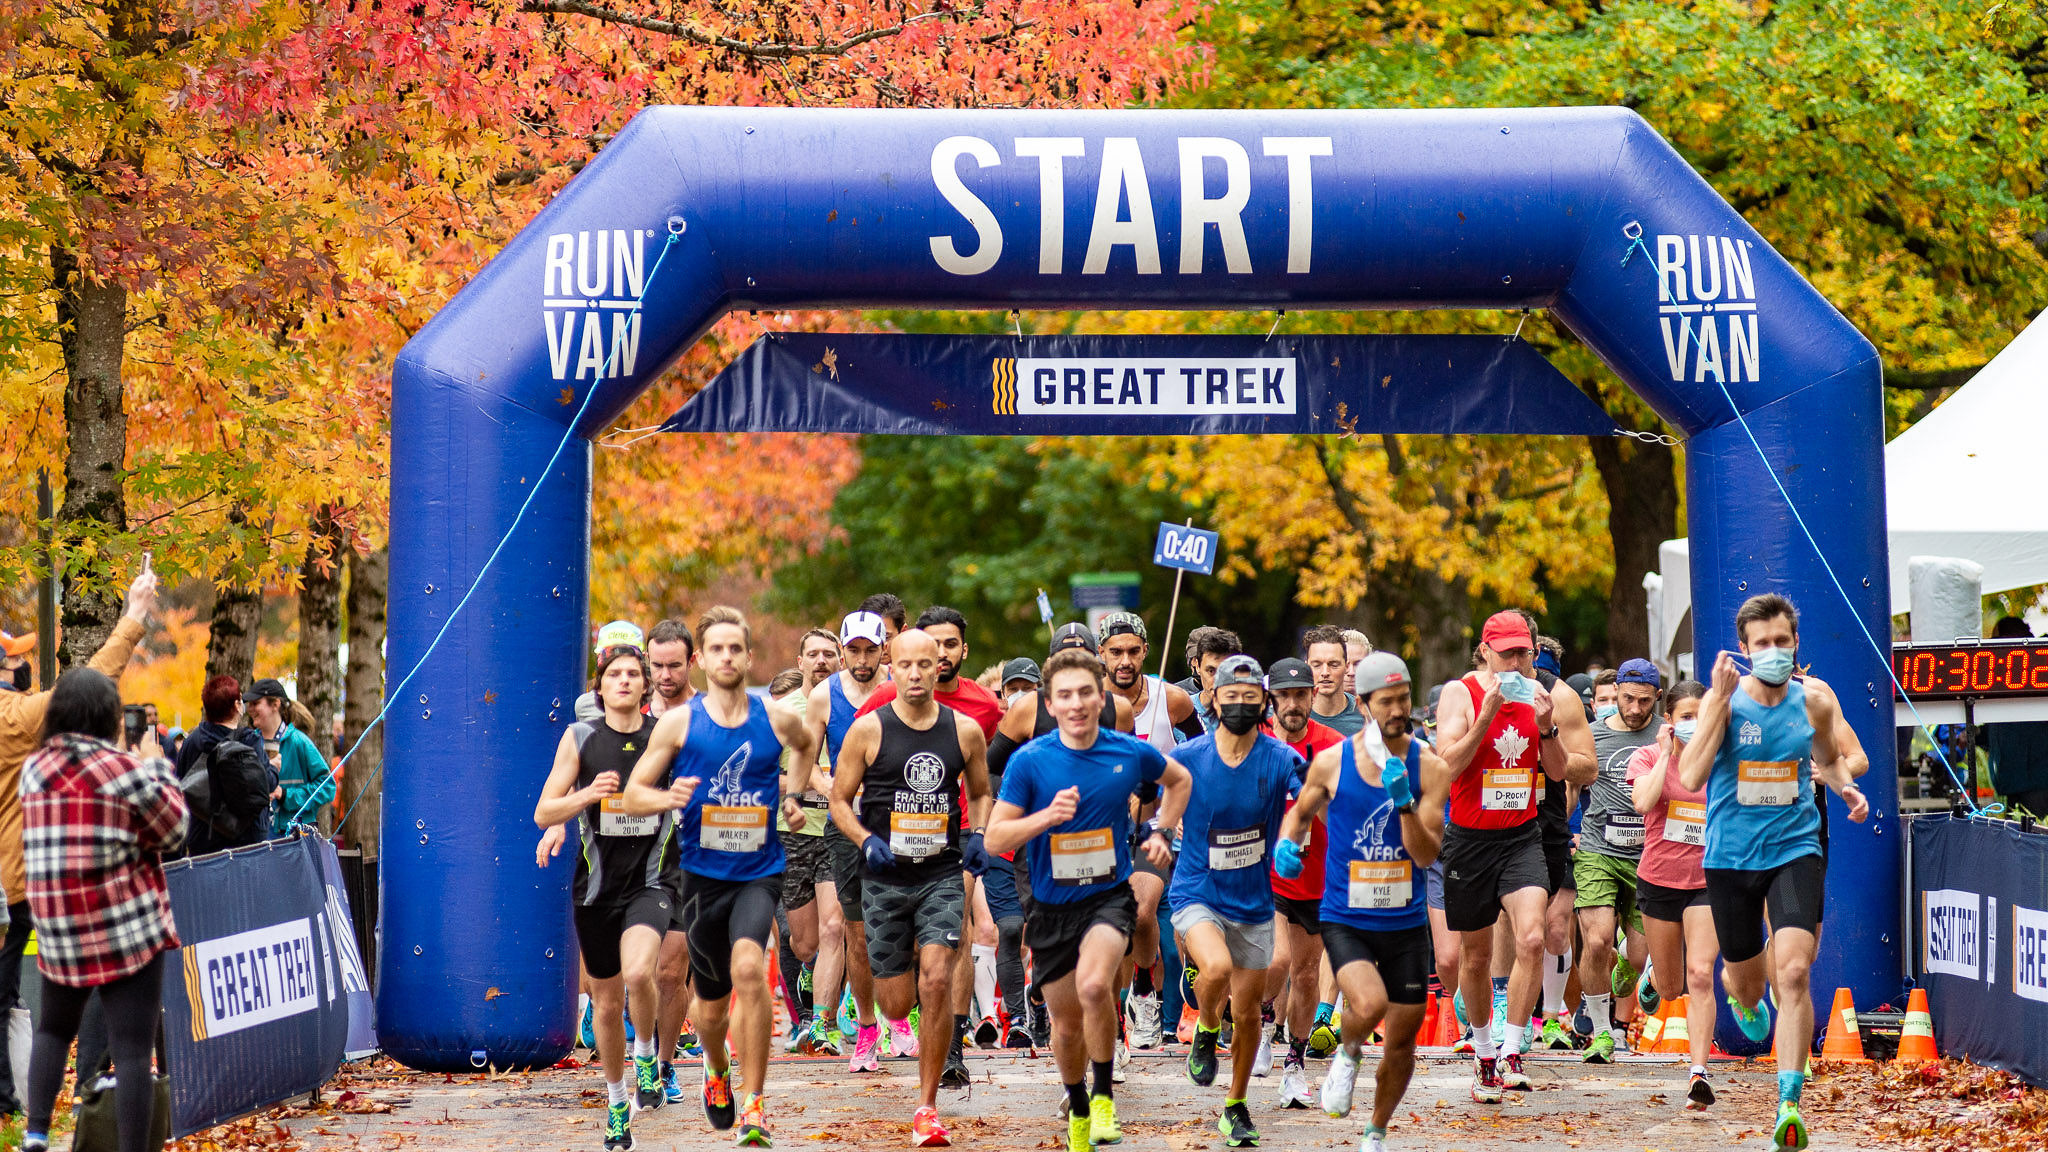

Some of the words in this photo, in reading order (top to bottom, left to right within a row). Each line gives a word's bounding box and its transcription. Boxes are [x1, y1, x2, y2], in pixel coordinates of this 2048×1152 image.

[929, 136, 1334, 276] START
[543, 229, 644, 297] RUN
[1657, 234, 1756, 302] RUN
[543, 310, 642, 380] VAN
[1659, 314, 1760, 383] VAN
[1033, 367, 1166, 406] GREAT
[1180, 367, 1286, 405] TREK
[1163, 530, 1208, 565] 0:40
[1902, 649, 2048, 692] 10:30:02
[1739, 735, 1762, 745] M2M
[719, 790, 763, 807] VFAC
[894, 791, 937, 803] FRASER
[1760, 795, 1777, 804] 2433
[894, 802, 919, 814] RUN
[922, 804, 950, 814] CLUB
[1503, 800, 1519, 809] 2409
[622, 826, 640, 835] 2010
[718, 829, 749, 840] WALKER
[1616, 829, 1645, 837] UMBERTO
[1684, 824, 1702, 834] ANNA
[904, 836, 934, 846] MICHAEL
[1684, 834, 1700, 844] 2005
[723, 841, 741, 851] 2001
[910, 847, 927, 856] 2003
[1225, 846, 1253, 858] MICHAEL
[1362, 845, 1404, 862] VFAC
[1076, 866, 1094, 877] 2419
[1373, 885, 1391, 896] KYLE
[1373, 897, 1391, 907] 2002
[1958, 907, 1977, 967] TREK
[2019, 925, 2047, 989] GRE
[208, 946, 271, 1021] GREAT
[272, 936, 314, 1004] TREK
